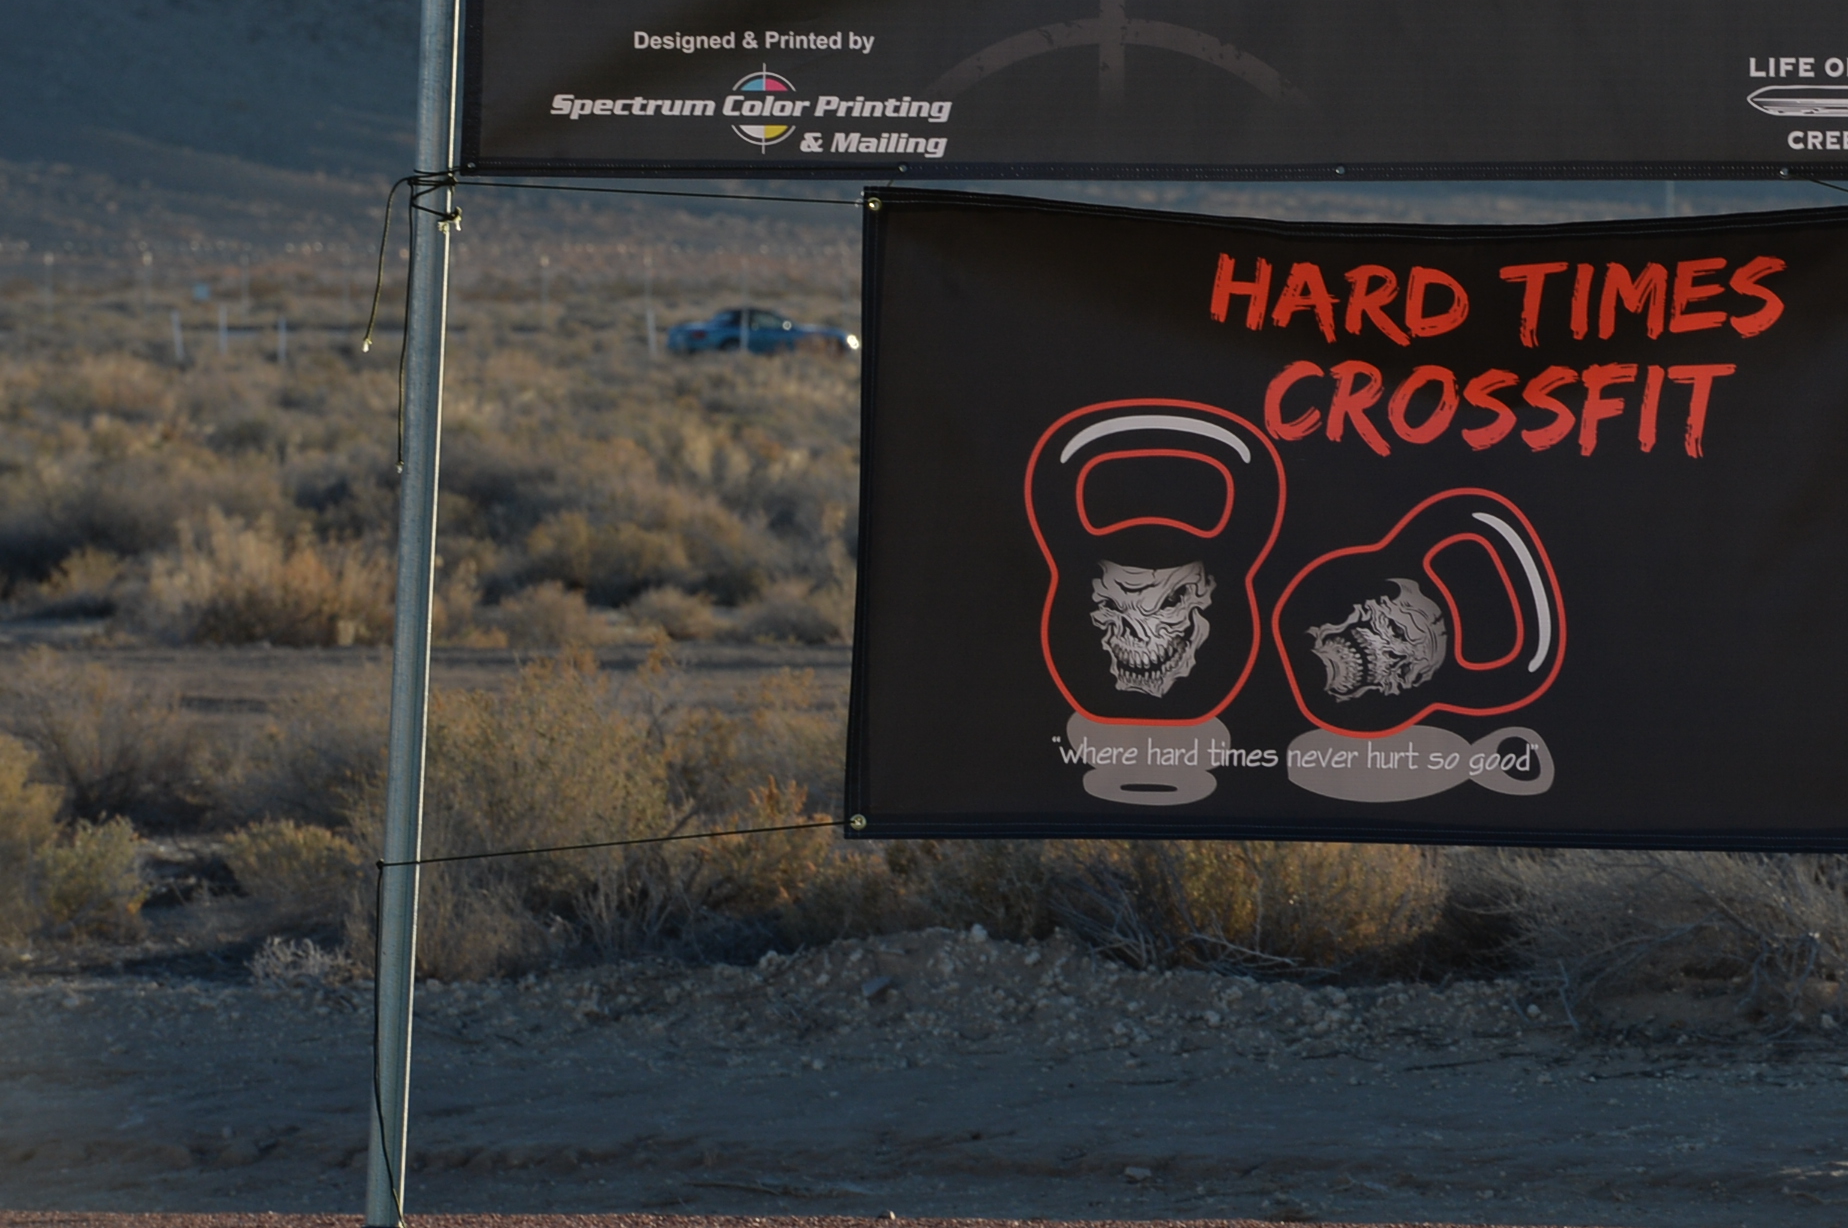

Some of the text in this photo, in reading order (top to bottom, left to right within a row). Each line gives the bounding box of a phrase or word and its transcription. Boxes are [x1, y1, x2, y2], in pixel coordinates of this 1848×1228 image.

[634, 31, 875, 53] Designed & Printed by
[1749, 57, 1815, 77] LIFE
[550, 94, 952, 122] Spectrum Color Printing
[800, 132, 947, 157] & Mailing
[1210, 253, 1787, 348] HARD TIMES
[1264, 360, 1737, 458] CROSSFIT
[1147, 738, 1198, 767] hard
[1207, 739, 1279, 768] times
[1287, 746, 1358, 769] never
[1367, 742, 1419, 770] hurt
[1427, 750, 1459, 771] so
